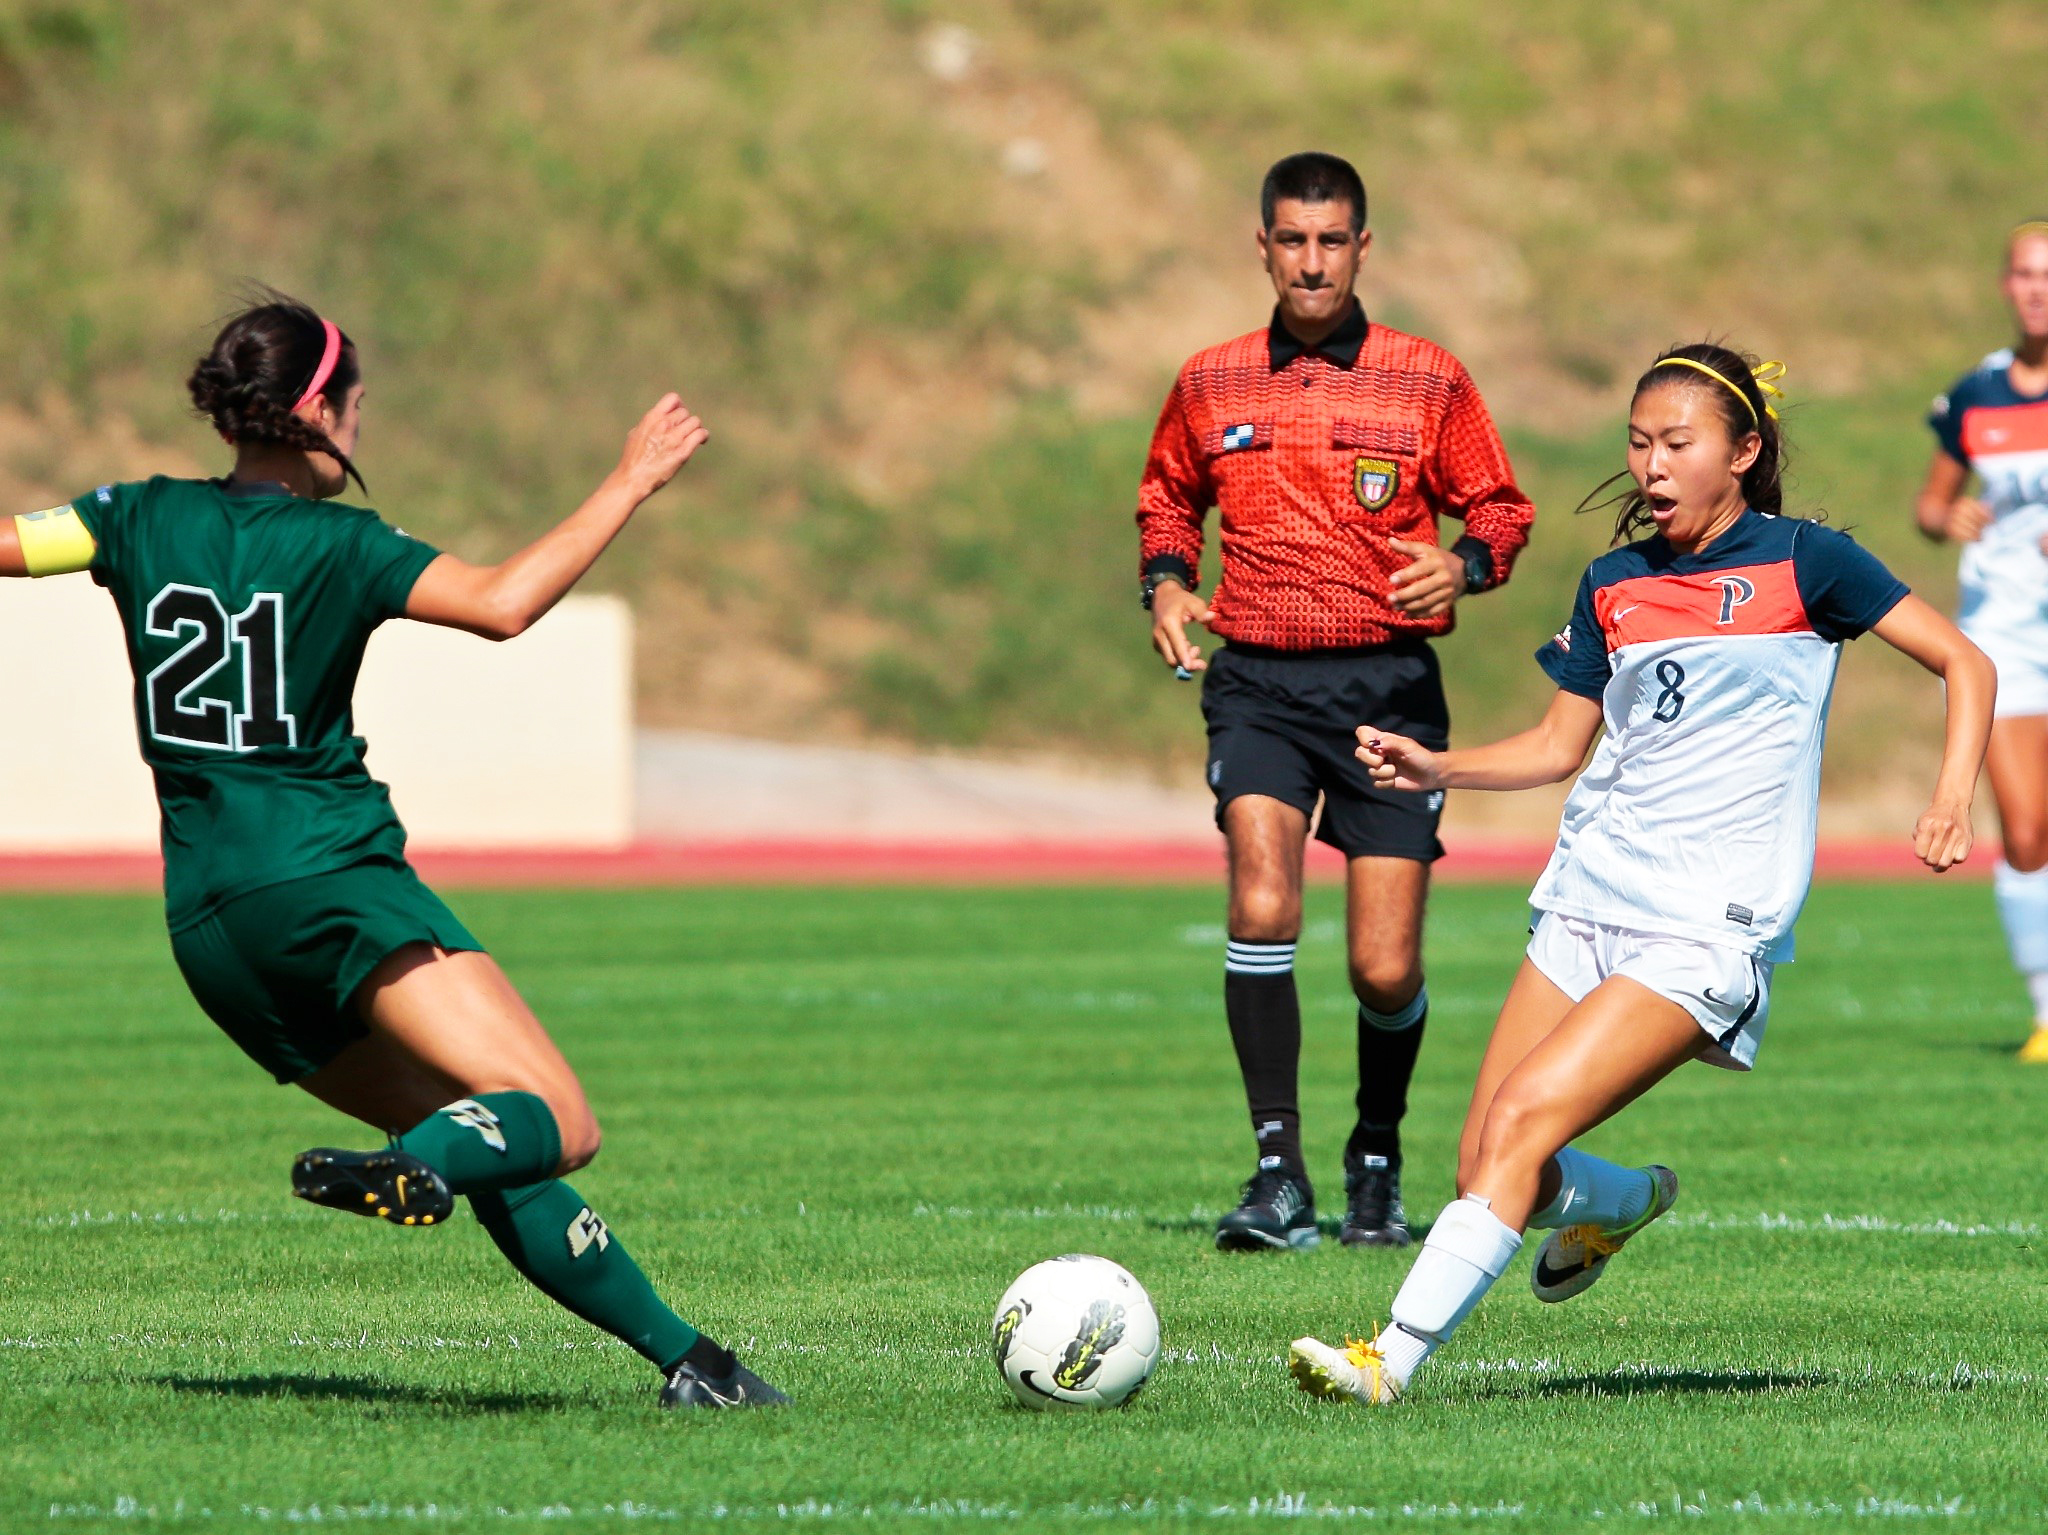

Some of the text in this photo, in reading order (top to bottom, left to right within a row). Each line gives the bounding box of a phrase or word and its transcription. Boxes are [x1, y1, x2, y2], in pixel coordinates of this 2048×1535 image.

[1710, 575, 1755, 624] P
[146, 582, 297, 752] 21
[1653, 660, 1685, 723] 8
